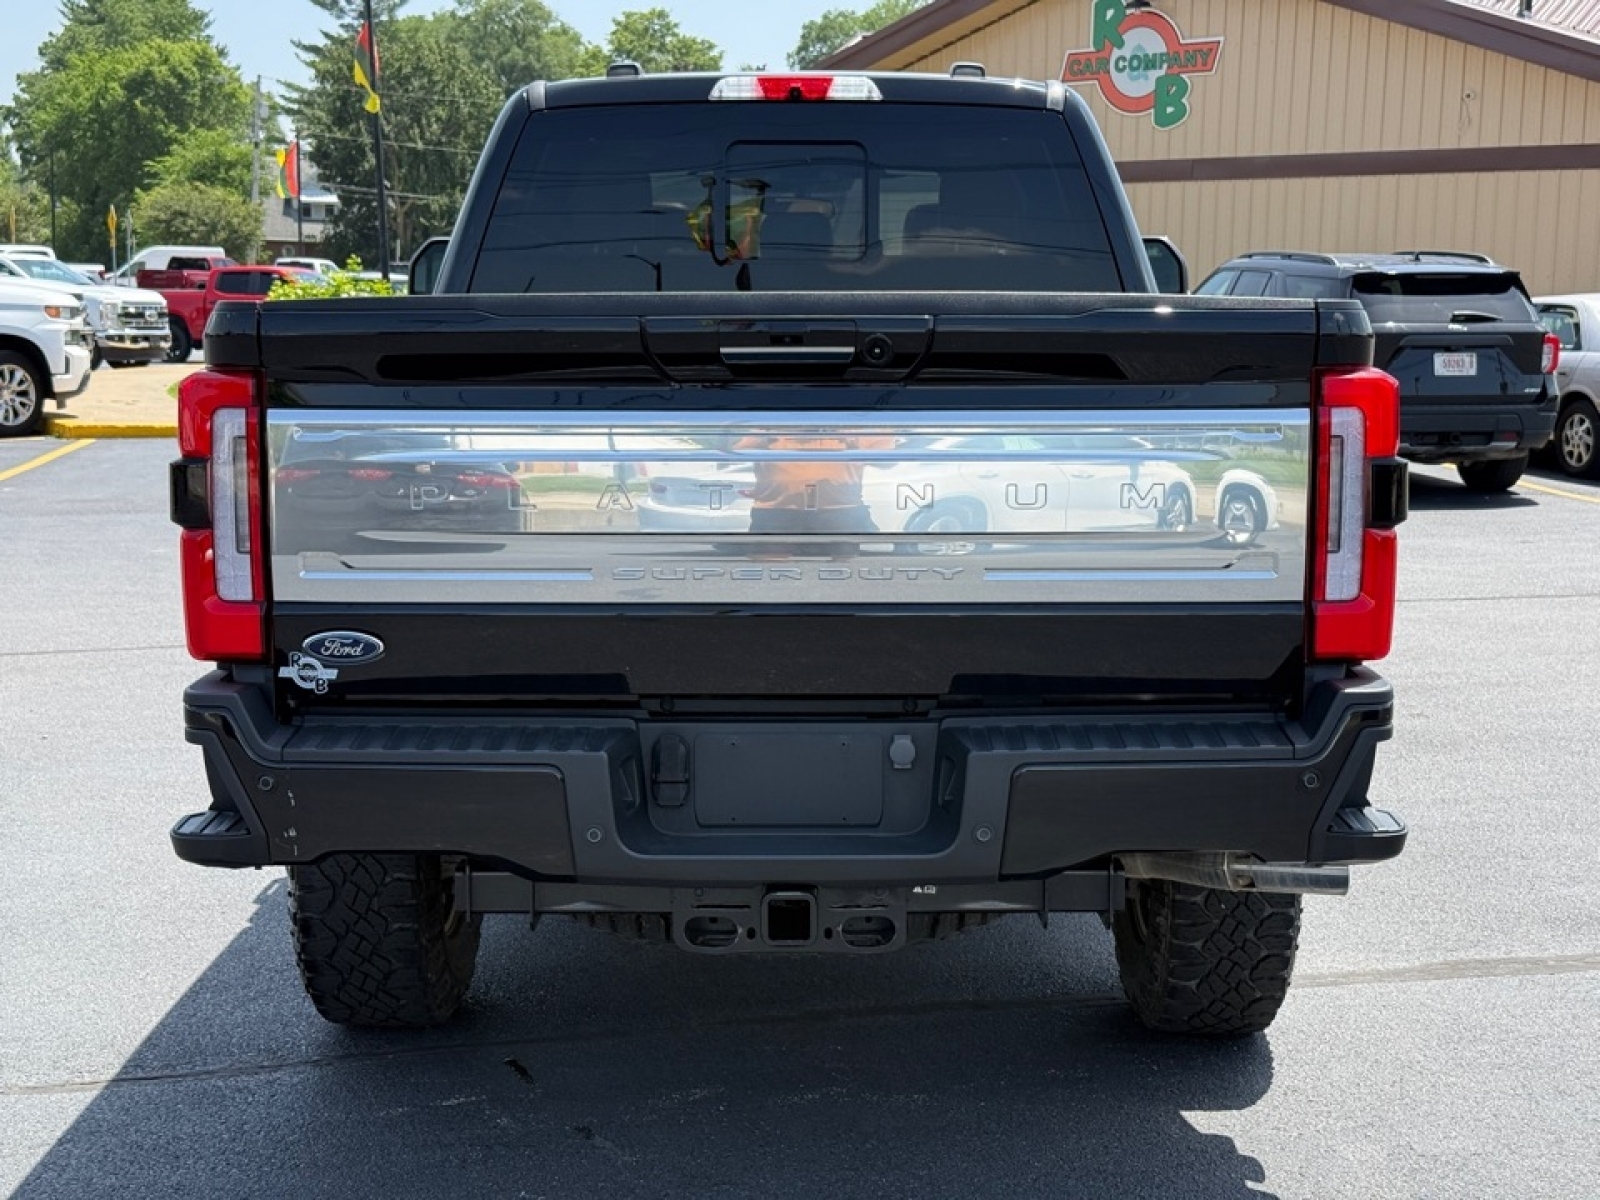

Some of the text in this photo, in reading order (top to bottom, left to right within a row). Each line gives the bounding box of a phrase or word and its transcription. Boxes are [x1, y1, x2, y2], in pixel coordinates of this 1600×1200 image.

[1069, 49, 1213, 76] CAR COMPANY
[1093, 0, 1126, 51] R
[1154, 74, 1189, 128] B
[409, 483, 1166, 511] PLATINUM
[612, 567, 964, 581] SUPER DUTY
[321, 638, 365, 656] Ford
